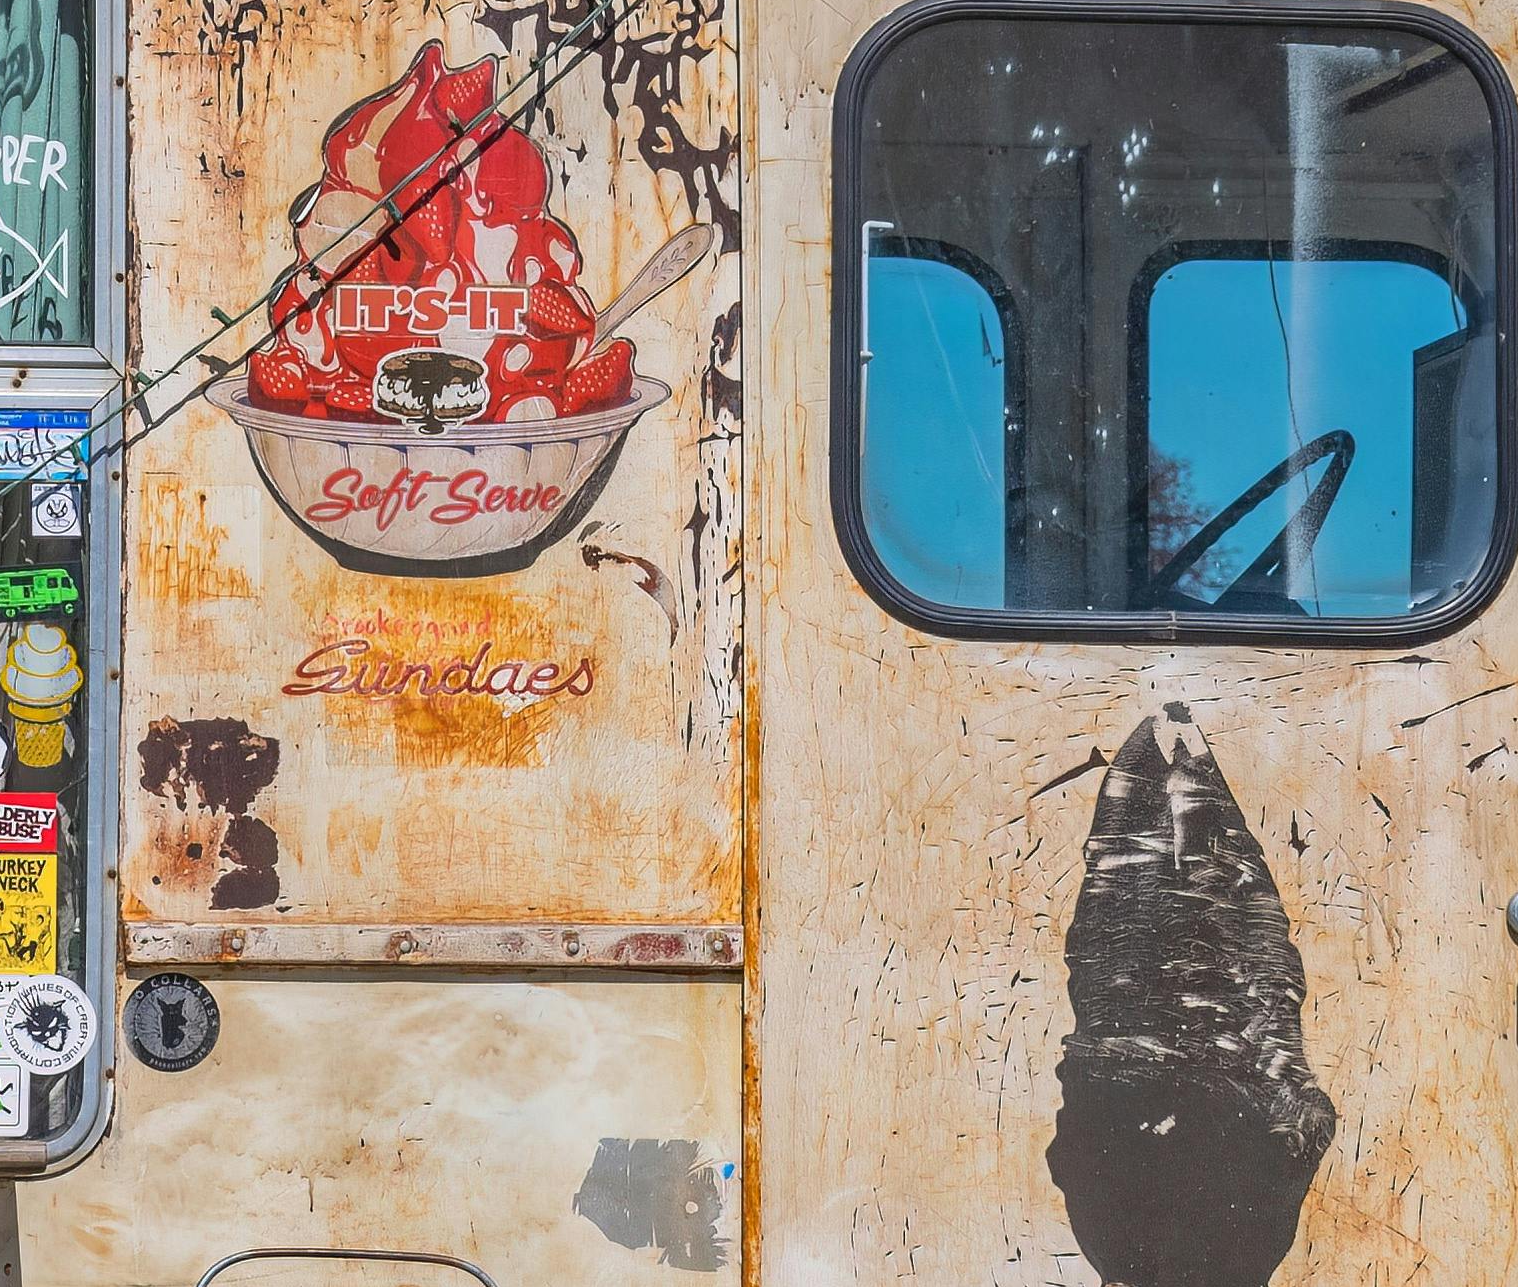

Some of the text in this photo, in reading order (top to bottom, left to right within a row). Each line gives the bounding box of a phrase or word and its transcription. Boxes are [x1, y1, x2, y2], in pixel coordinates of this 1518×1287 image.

[305, 467, 567, 532] Soft Serve
[280, 638, 596, 696] Sundaes
[150, 974, 217, 1016] COLLARS
